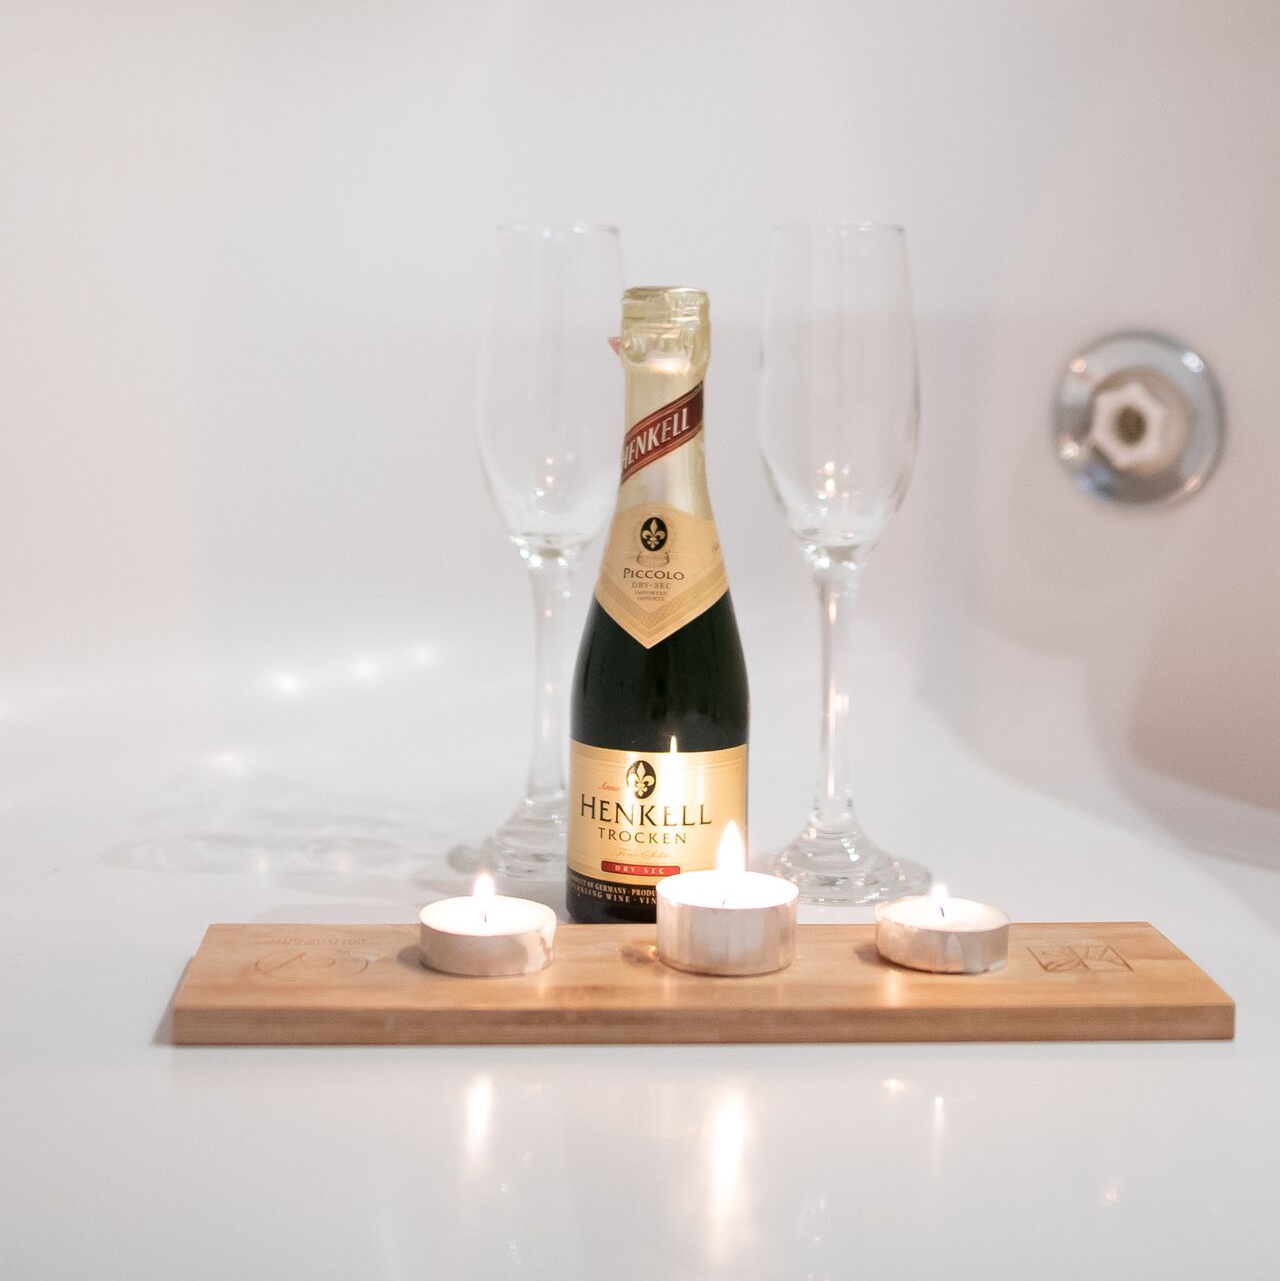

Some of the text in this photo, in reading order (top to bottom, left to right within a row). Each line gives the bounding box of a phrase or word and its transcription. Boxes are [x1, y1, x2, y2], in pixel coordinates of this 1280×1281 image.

[623, 567, 685, 581] PICCOLO
[579, 793, 713, 827] HENKELL
[598, 827, 687, 845] TROCKEN
[594, 883, 627, 895] GERMANY
[606, 893, 631, 903] WINE
